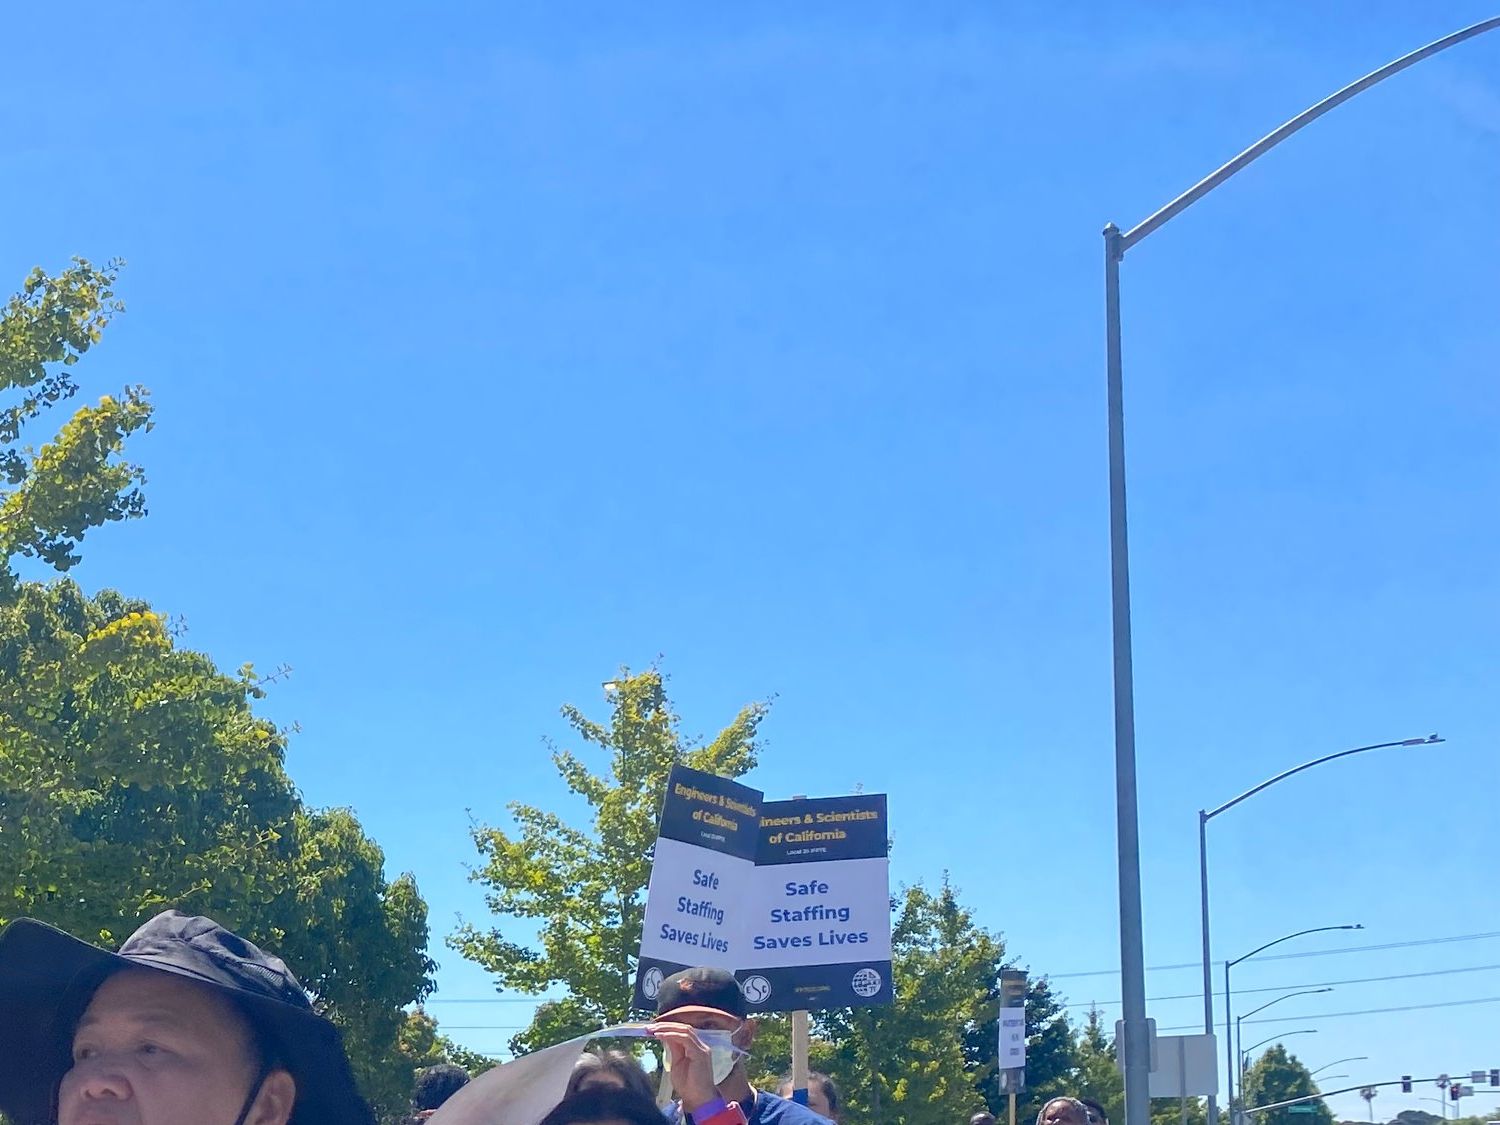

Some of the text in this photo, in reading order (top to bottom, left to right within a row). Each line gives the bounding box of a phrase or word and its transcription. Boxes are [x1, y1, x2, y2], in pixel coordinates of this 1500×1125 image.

[674, 783, 717, 804] Engineers
[719, 795, 725, 807] &
[692, 809, 738, 832] of California
[759, 809, 878, 827] ineers & Scientists
[769, 828, 846, 844] of California
[692, 869, 719, 890] Safe
[785, 880, 829, 896] Safe
[677, 896, 724, 925] Staffing
[770, 904, 850, 923] Staffing
[660, 923, 729, 953] Saves Lives
[753, 929, 869, 950] Saves Lives
